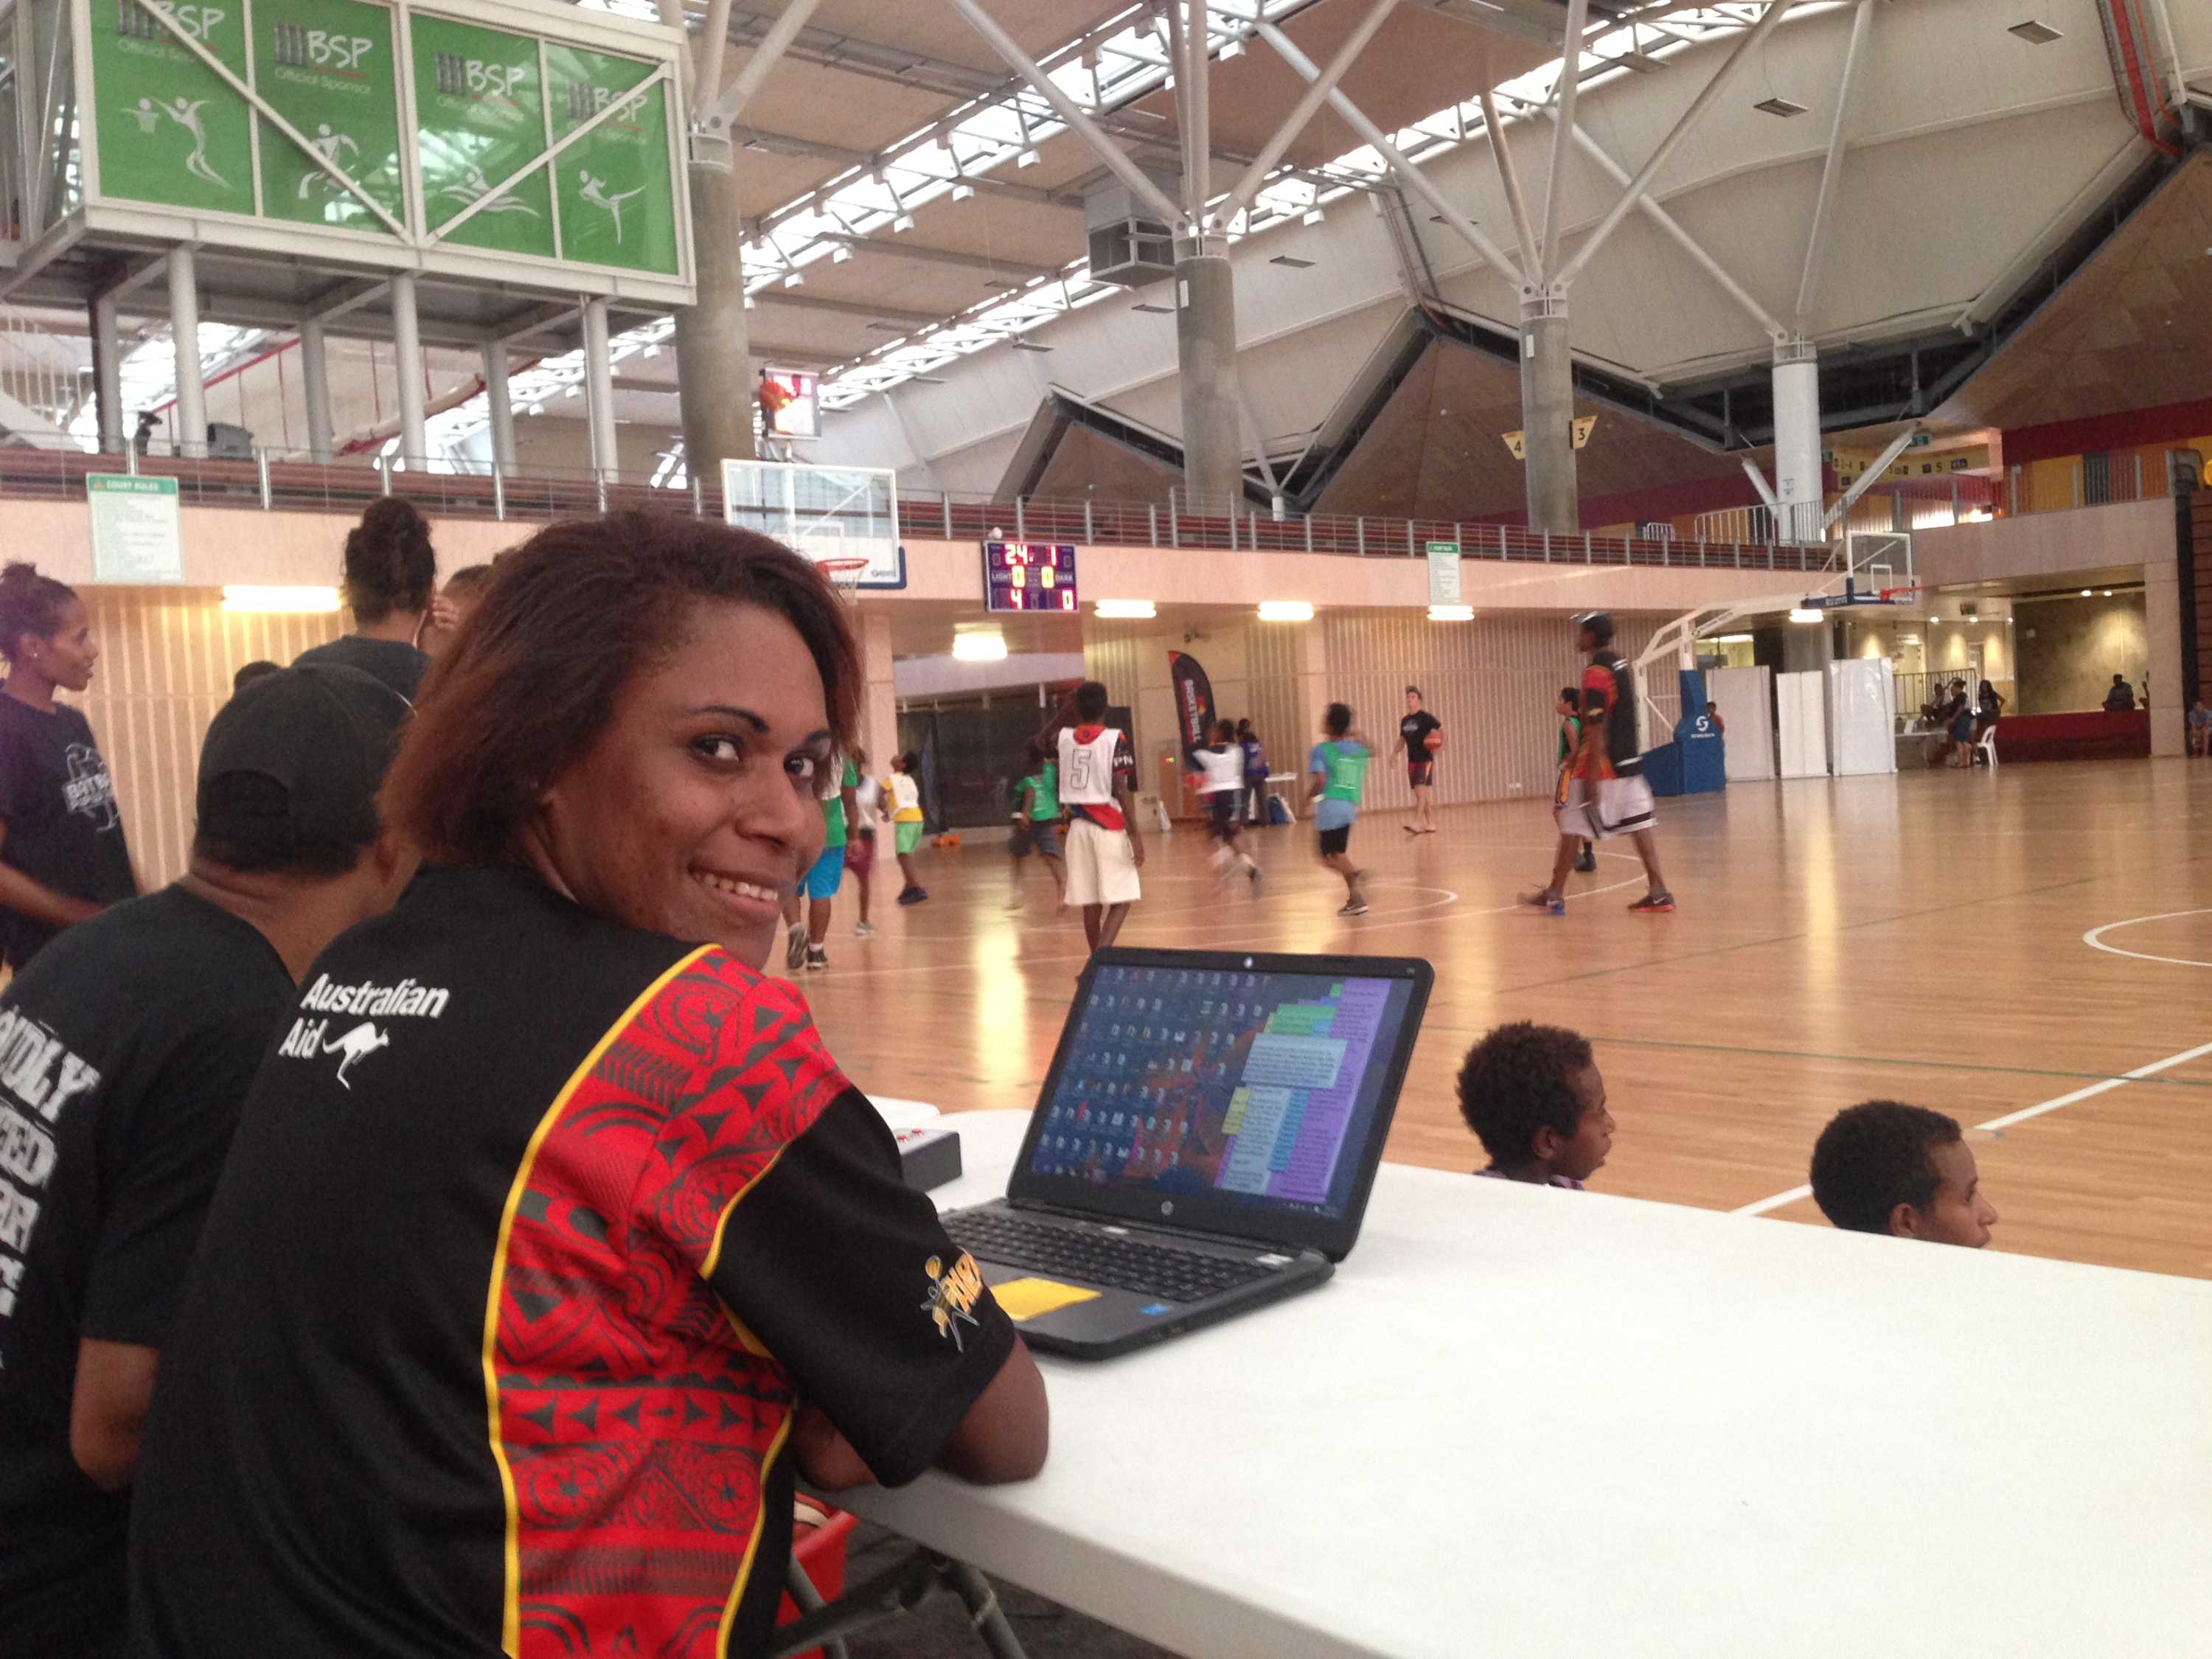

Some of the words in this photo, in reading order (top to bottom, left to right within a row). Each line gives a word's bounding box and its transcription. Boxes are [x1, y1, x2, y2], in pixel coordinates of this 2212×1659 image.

[307, 30, 373, 69] BSP
[465, 59, 526, 97] BSP
[1514, 441, 1522, 453] 4
[1578, 428, 1585, 441] 3
[1010, 590, 1023, 610] 4
[1071, 748, 1091, 790] 5
[299, 973, 451, 1018] Australian
[278, 1017, 330, 1059] Aid
